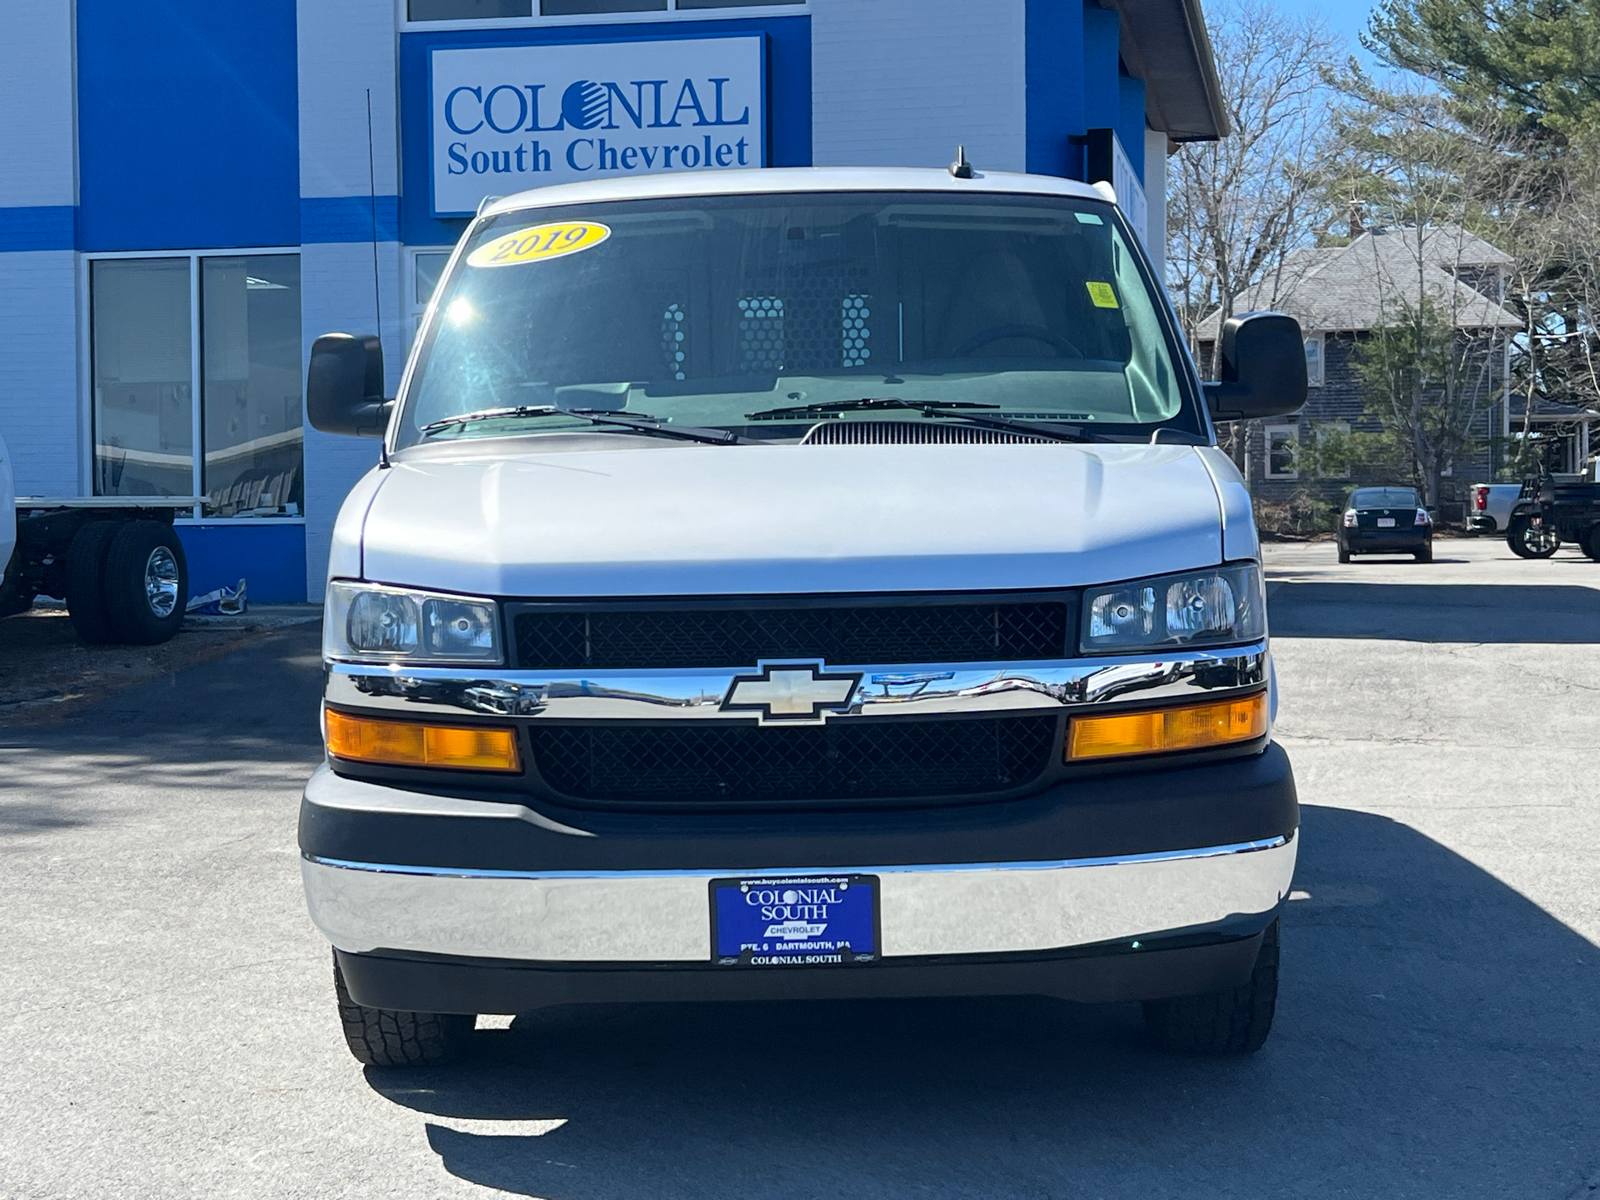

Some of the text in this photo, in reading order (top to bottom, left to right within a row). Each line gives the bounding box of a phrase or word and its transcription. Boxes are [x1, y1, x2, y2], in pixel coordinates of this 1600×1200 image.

[445, 78, 749, 134] COLONIAL
[448, 135, 749, 175] South Chevrolet
[488, 226, 588, 262] 2019
[740, 877, 849, 886] www.buycolonialsouth.com
[745, 888, 843, 906] COLONIAL
[761, 904, 829, 921] SOUTH
[770, 925, 821, 935] CHEVROLET
[762, 942, 769, 951] 6
[775, 941, 835, 951] DARTMOUTH,
[750, 954, 842, 965] COLONIAL SOUTH
